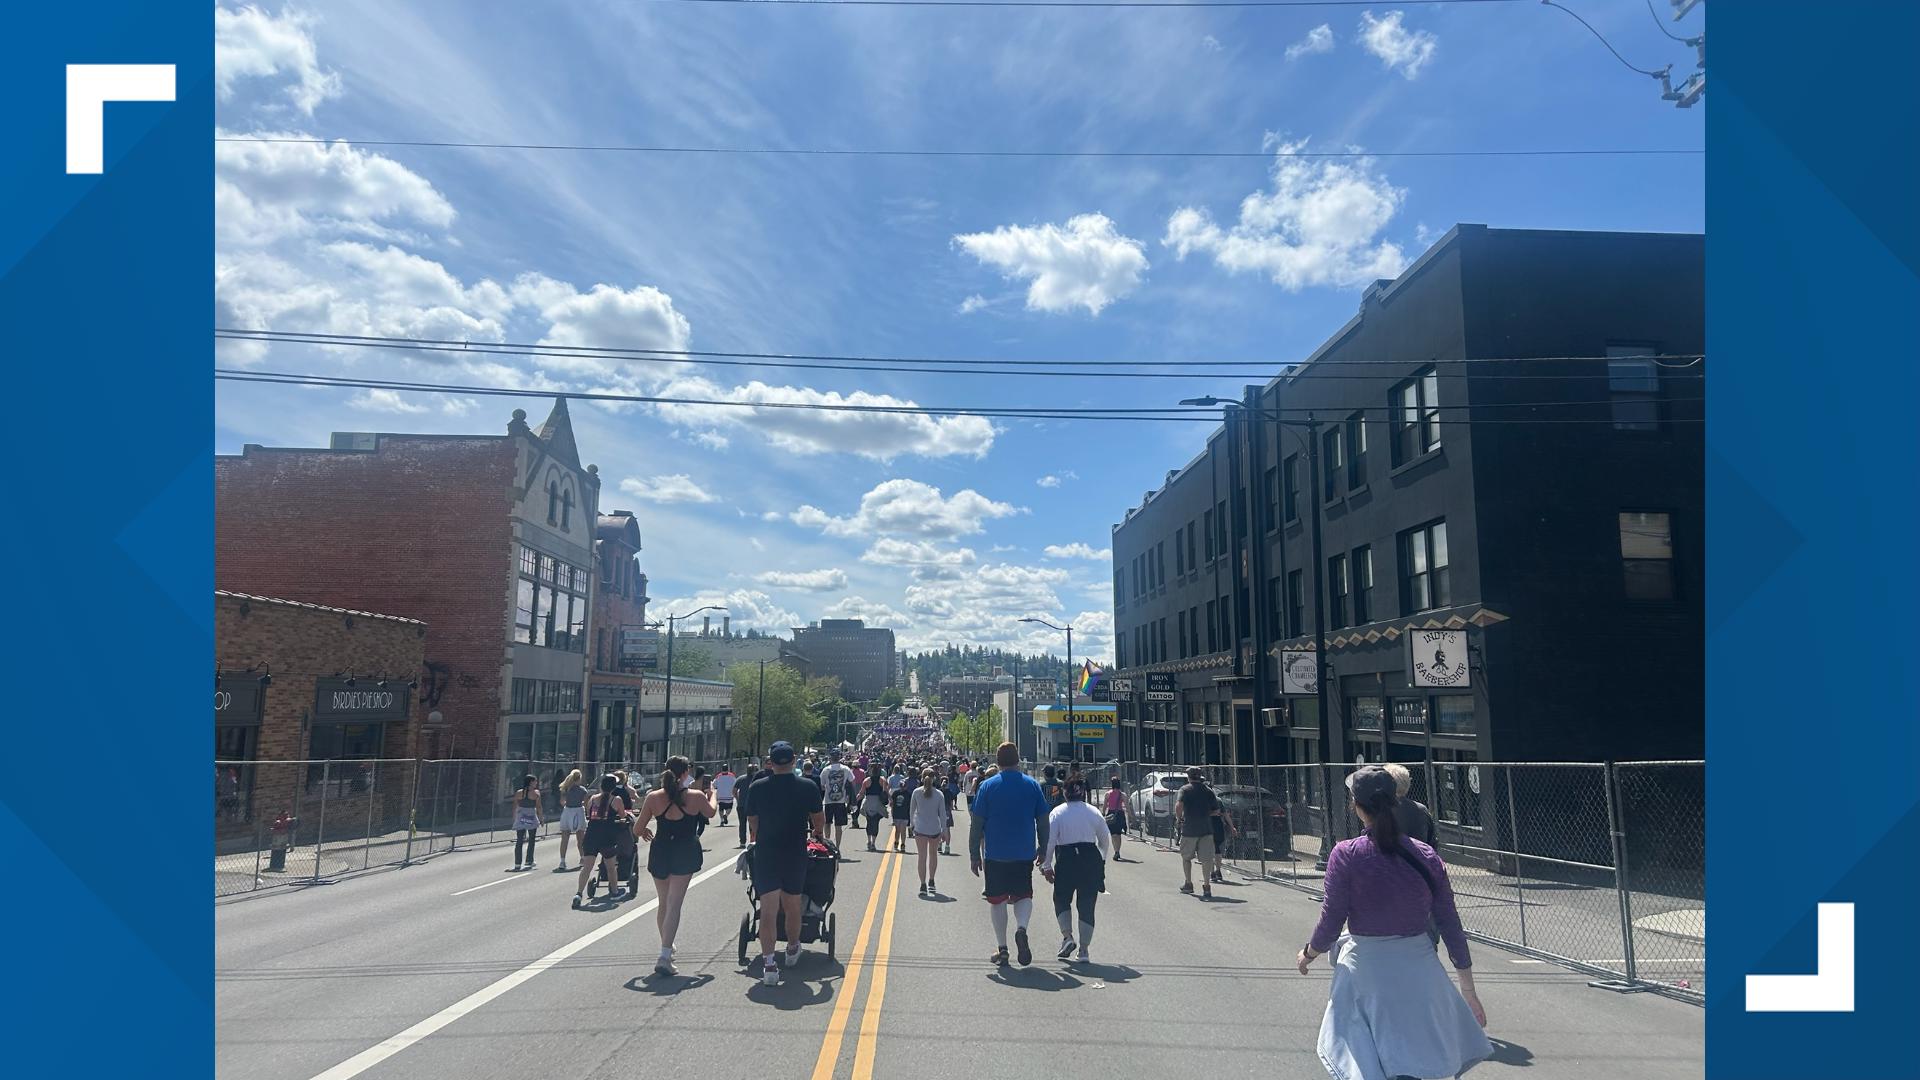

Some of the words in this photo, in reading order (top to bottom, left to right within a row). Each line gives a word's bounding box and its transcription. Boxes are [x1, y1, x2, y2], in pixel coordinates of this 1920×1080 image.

[1423, 631, 1457, 644] INDY'S
[1415, 662, 1467, 686] BARBERSHOP
[1111, 691, 1132, 702] LOUNGE
[1063, 714, 1114, 723] GOLDEN
